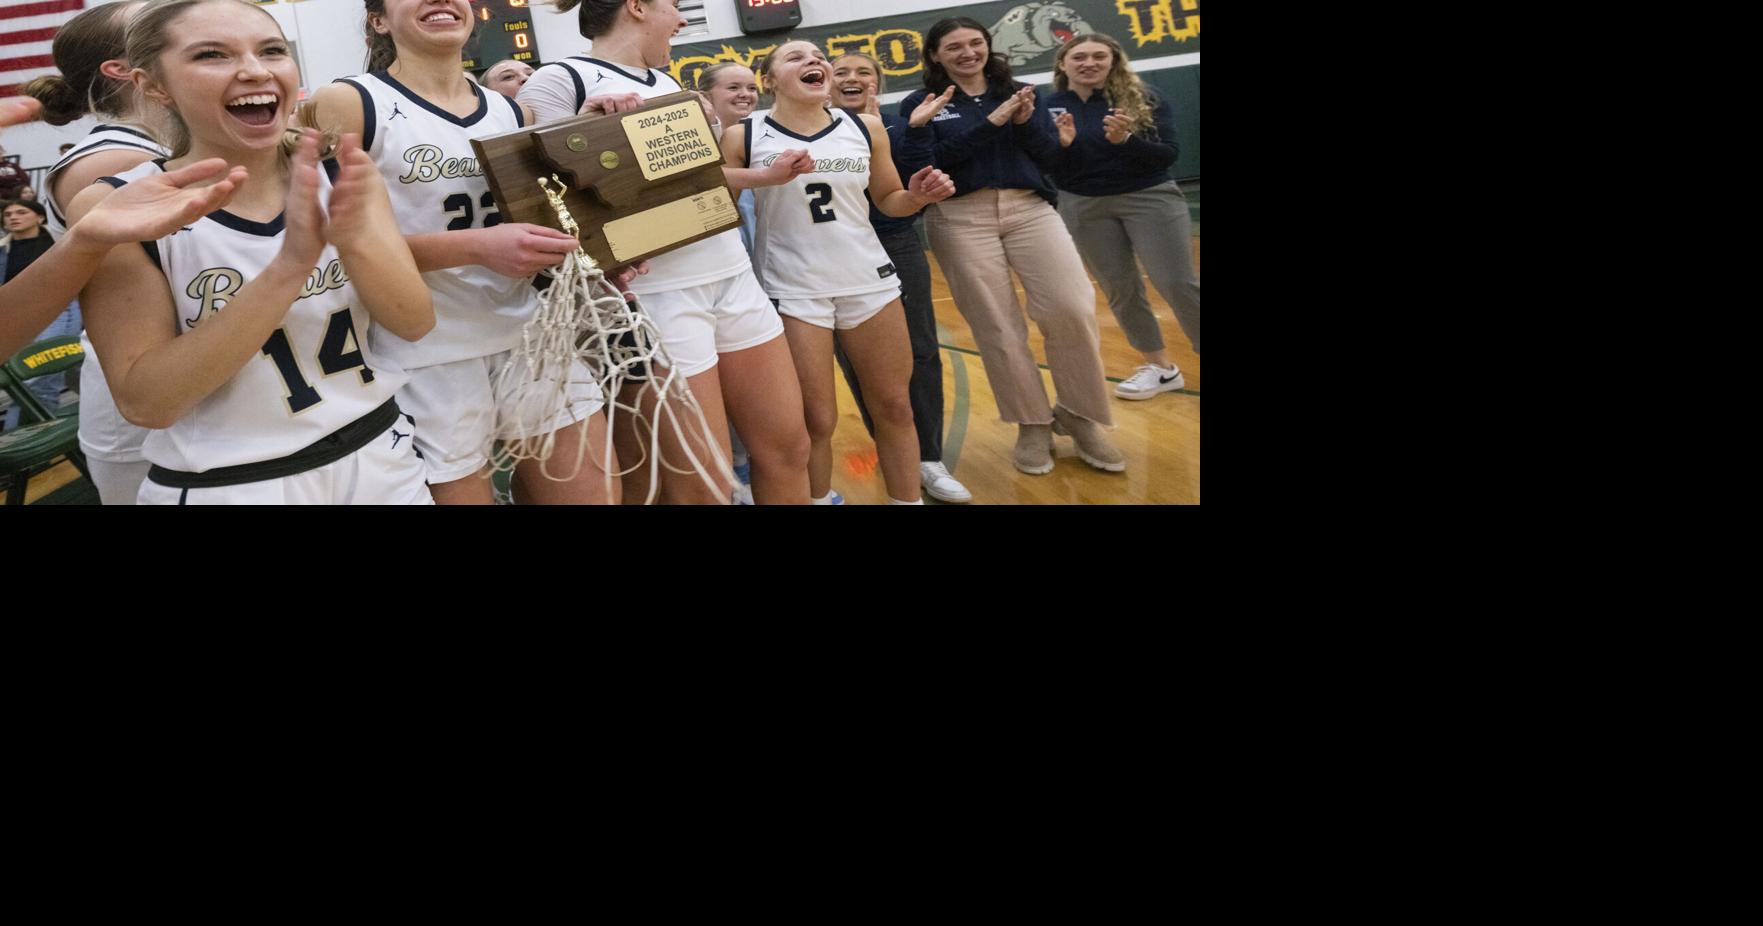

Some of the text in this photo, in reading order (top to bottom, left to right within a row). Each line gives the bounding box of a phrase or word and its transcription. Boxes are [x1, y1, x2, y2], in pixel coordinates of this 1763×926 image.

[504, 20, 529, 32] fouls
[515, 32, 529, 49] 0
[513, 51, 532, 61] won
[638, 108, 689, 129] 2024-2025
[664, 124, 674, 134] A
[645, 128, 699, 150] WESTERN
[646, 139, 706, 162] DIVISIONAL
[649, 147, 712, 173] CHAMPIONS
[804, 181, 838, 225] 2
[260, 304, 376, 417] 14
